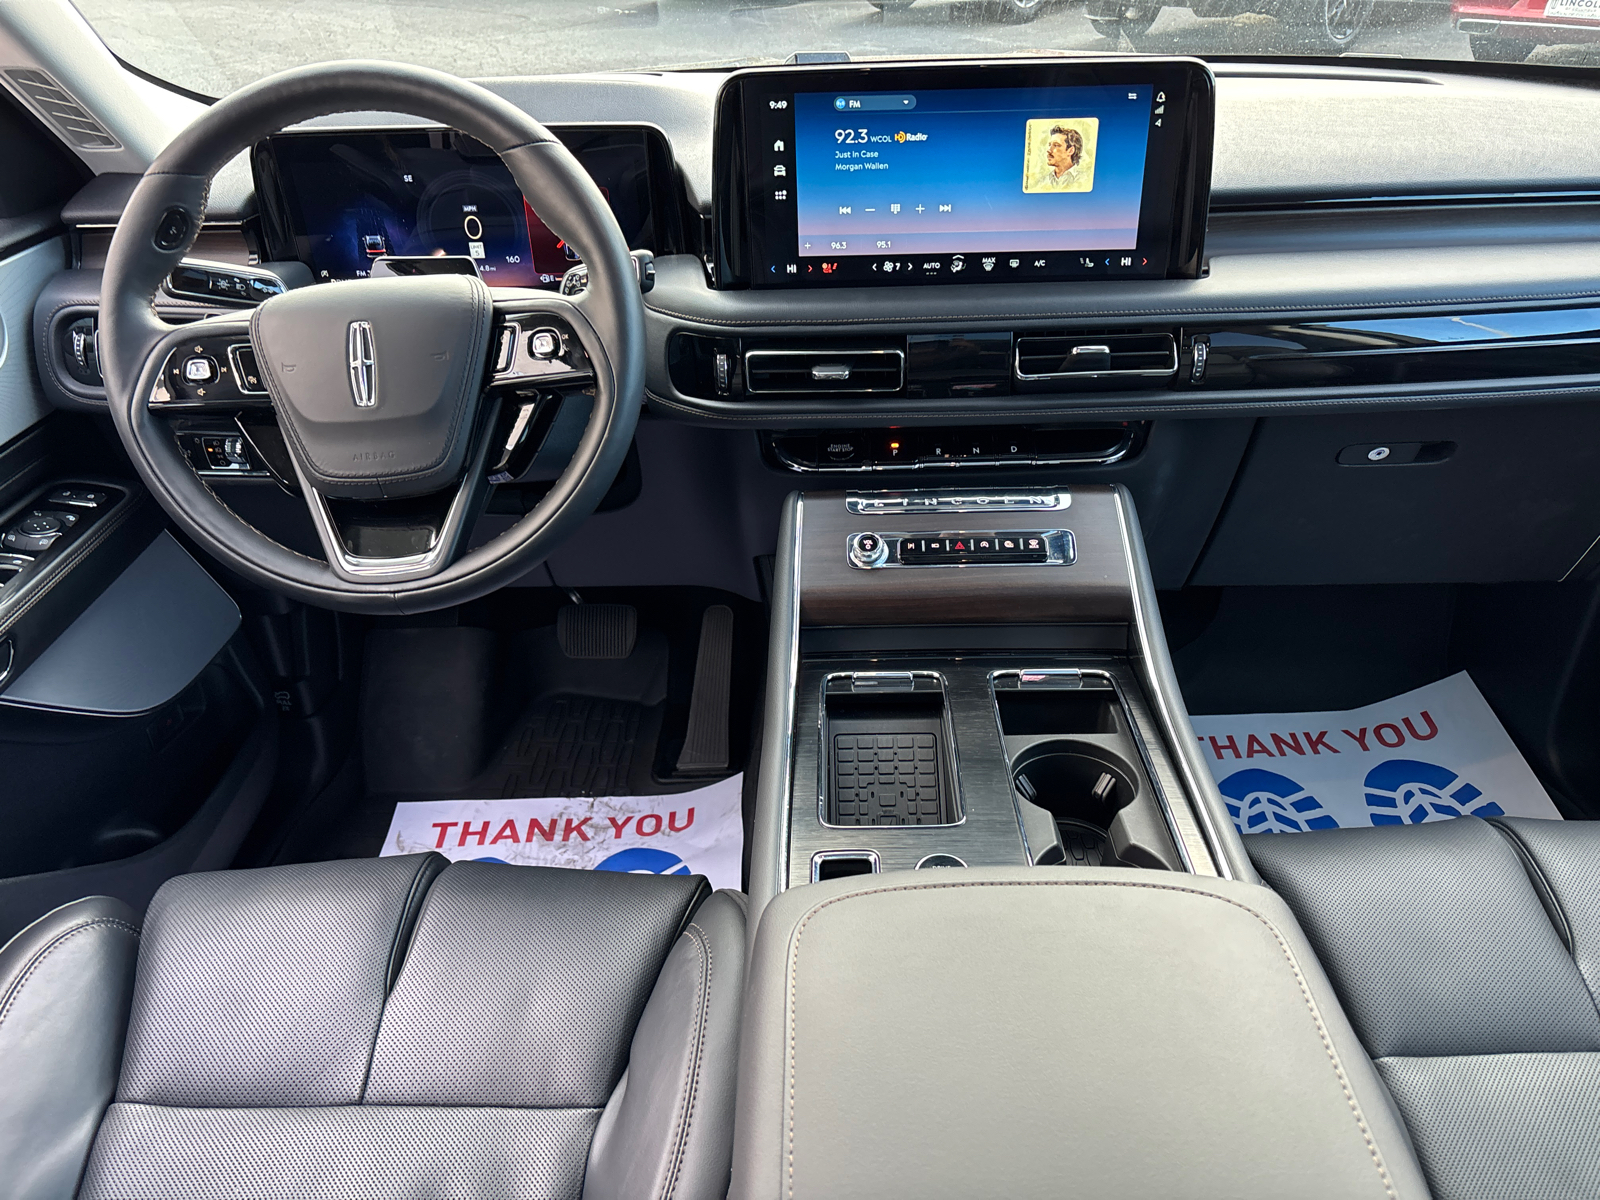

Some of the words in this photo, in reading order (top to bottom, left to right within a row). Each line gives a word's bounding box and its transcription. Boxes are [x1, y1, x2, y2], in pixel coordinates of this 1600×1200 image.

[1560, 0, 1600, 8] LINCOL
[769, 101, 788, 109] 9:49
[849, 100, 861, 109] FM
[834, 129, 868, 144] 92.3
[870, 135, 892, 143] WCOL
[861, 150, 879, 158] Case
[835, 163, 863, 172] Morgan
[864, 162, 889, 170] Wallen
[403, 174, 413, 183] SE
[831, 241, 847, 250] 96.3
[876, 240, 891, 249] 95.1
[506, 255, 521, 263] 160
[1034, 259, 1046, 267] A/C
[1121, 257, 1132, 266] HI
[787, 264, 797, 274] HI
[895, 263, 901, 271] 7
[353, 450, 396, 462] AIRBAG
[873, 496, 1043, 507] LINCOLN
[1197, 730, 1341, 760] HANK
[1342, 710, 1439, 752] YOU
[431, 816, 591, 849] THANK
[607, 806, 696, 840] YOU
